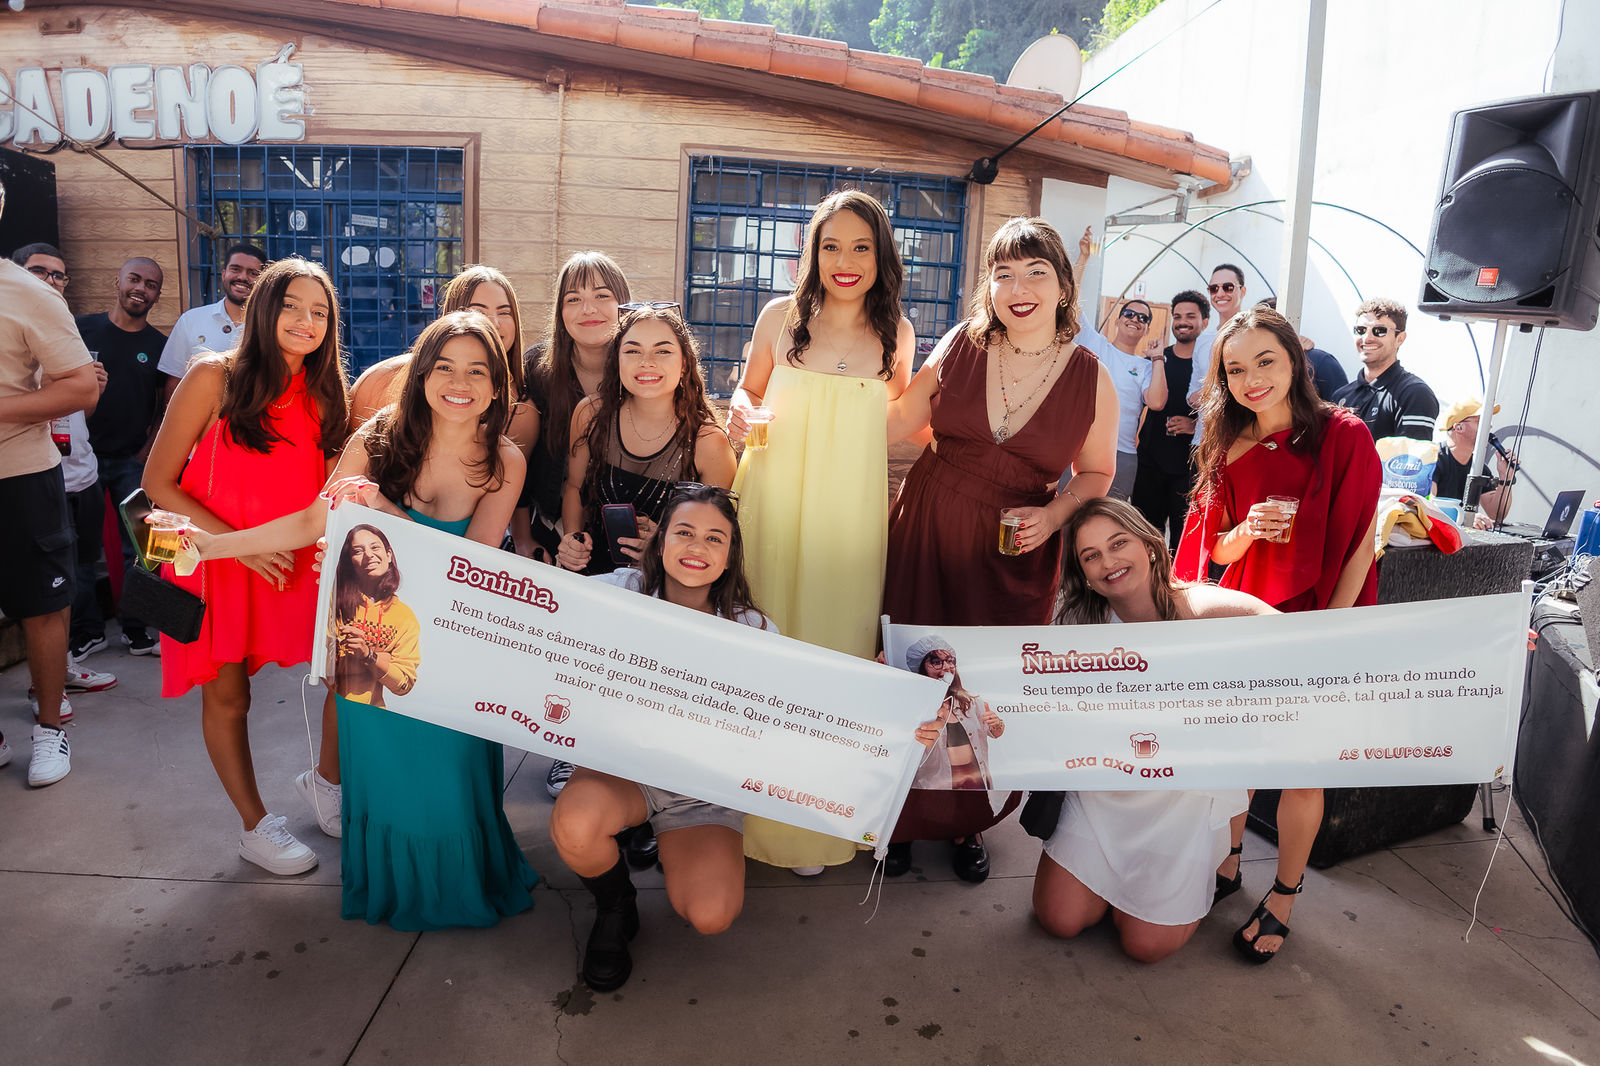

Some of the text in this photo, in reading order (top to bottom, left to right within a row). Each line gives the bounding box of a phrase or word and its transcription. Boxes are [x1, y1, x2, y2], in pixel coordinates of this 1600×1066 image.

[1390, 460, 1422, 471] Camil
[447, 556, 559, 613] Boninha,
[450, 600, 884, 738] Nem todas as câmeras do BBB seriam capazes de gerar o mesmo
[1022, 642, 1148, 674] Ñintendo,
[434, 616, 889, 758] entretenimento que você gerou nessa cidade. Que o seu sucesso seja
[997, 684, 1504, 713] conhecê-la. Que muitas portas se abram para você, tal qual a sua franja
[1023, 668, 1476, 698] Seu tempo de fazer arte em casa passou, agora é hora do mundo
[554, 671, 764, 740] maior que o som da sua risada!
[1184, 711, 1299, 724] no meio do rock!
[474, 700, 576, 748] axa axa axa
[1066, 756, 1174, 778] axa axa axa
[1339, 746, 1453, 760] AS VOLUPOSAS
[741, 778, 856, 819] AS VOLUPOSAS
